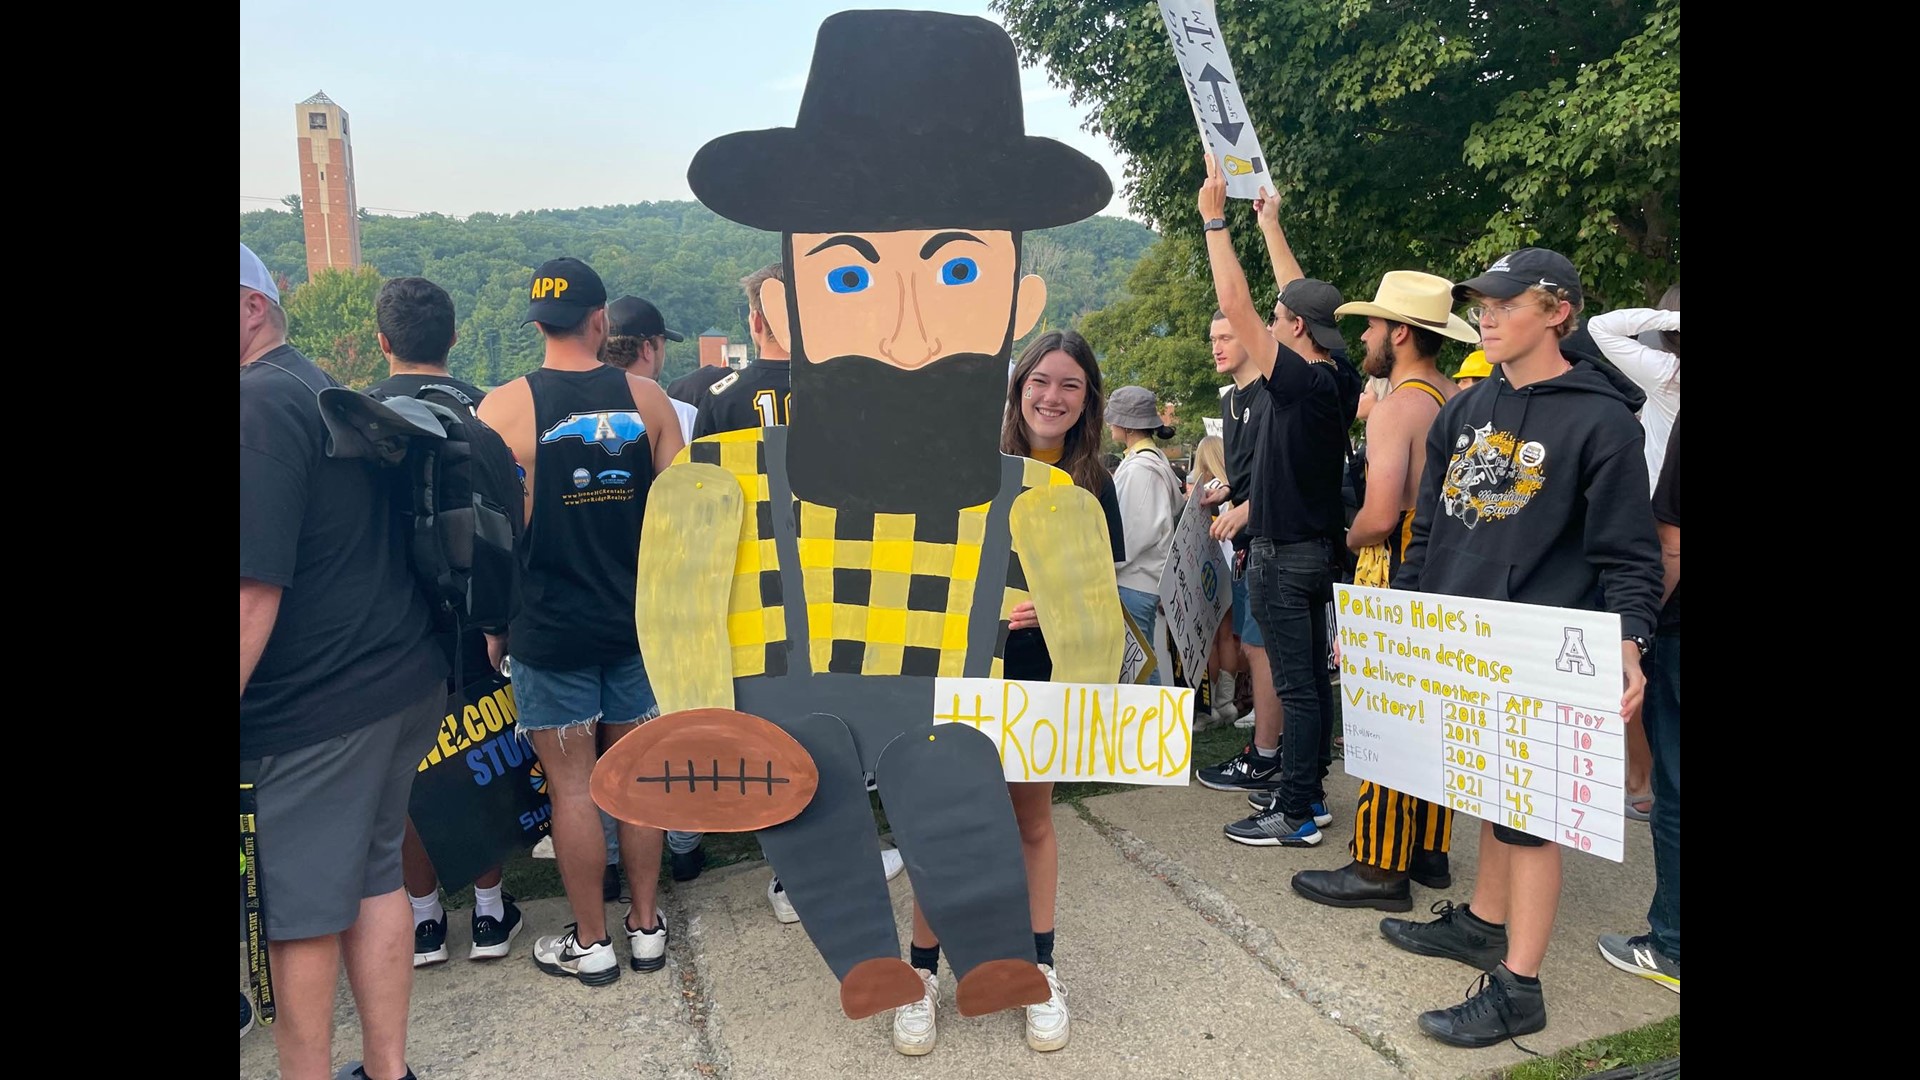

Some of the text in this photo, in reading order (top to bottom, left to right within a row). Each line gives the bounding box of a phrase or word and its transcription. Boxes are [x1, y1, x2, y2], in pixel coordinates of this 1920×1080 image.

[1206, 94, 1219, 113] 83
[531, 277, 568, 300] APP
[1410, 600, 1467, 633] Holes
[1475, 615, 1492, 637] in
[1341, 627, 1513, 684] the Trojan defense
[1342, 655, 1491, 707] to deliver another
[1344, 684, 1425, 723] Victory!
[1444, 703, 1592, 750] 2018 21 10
[1505, 696, 1605, 730] APP Troy
[1346, 744, 1379, 762] #ESPN
[1444, 722, 1594, 776] 2019 48 13
[1445, 746, 1592, 804] 2020 47 10
[1445, 769, 1585, 830] 2021 45 7
[1446, 793, 1592, 851] Total 161 40
[245, 837, 257, 898] APPALACHIAN STATE
[249, 912, 259, 973] APPALACHIAN STATE
